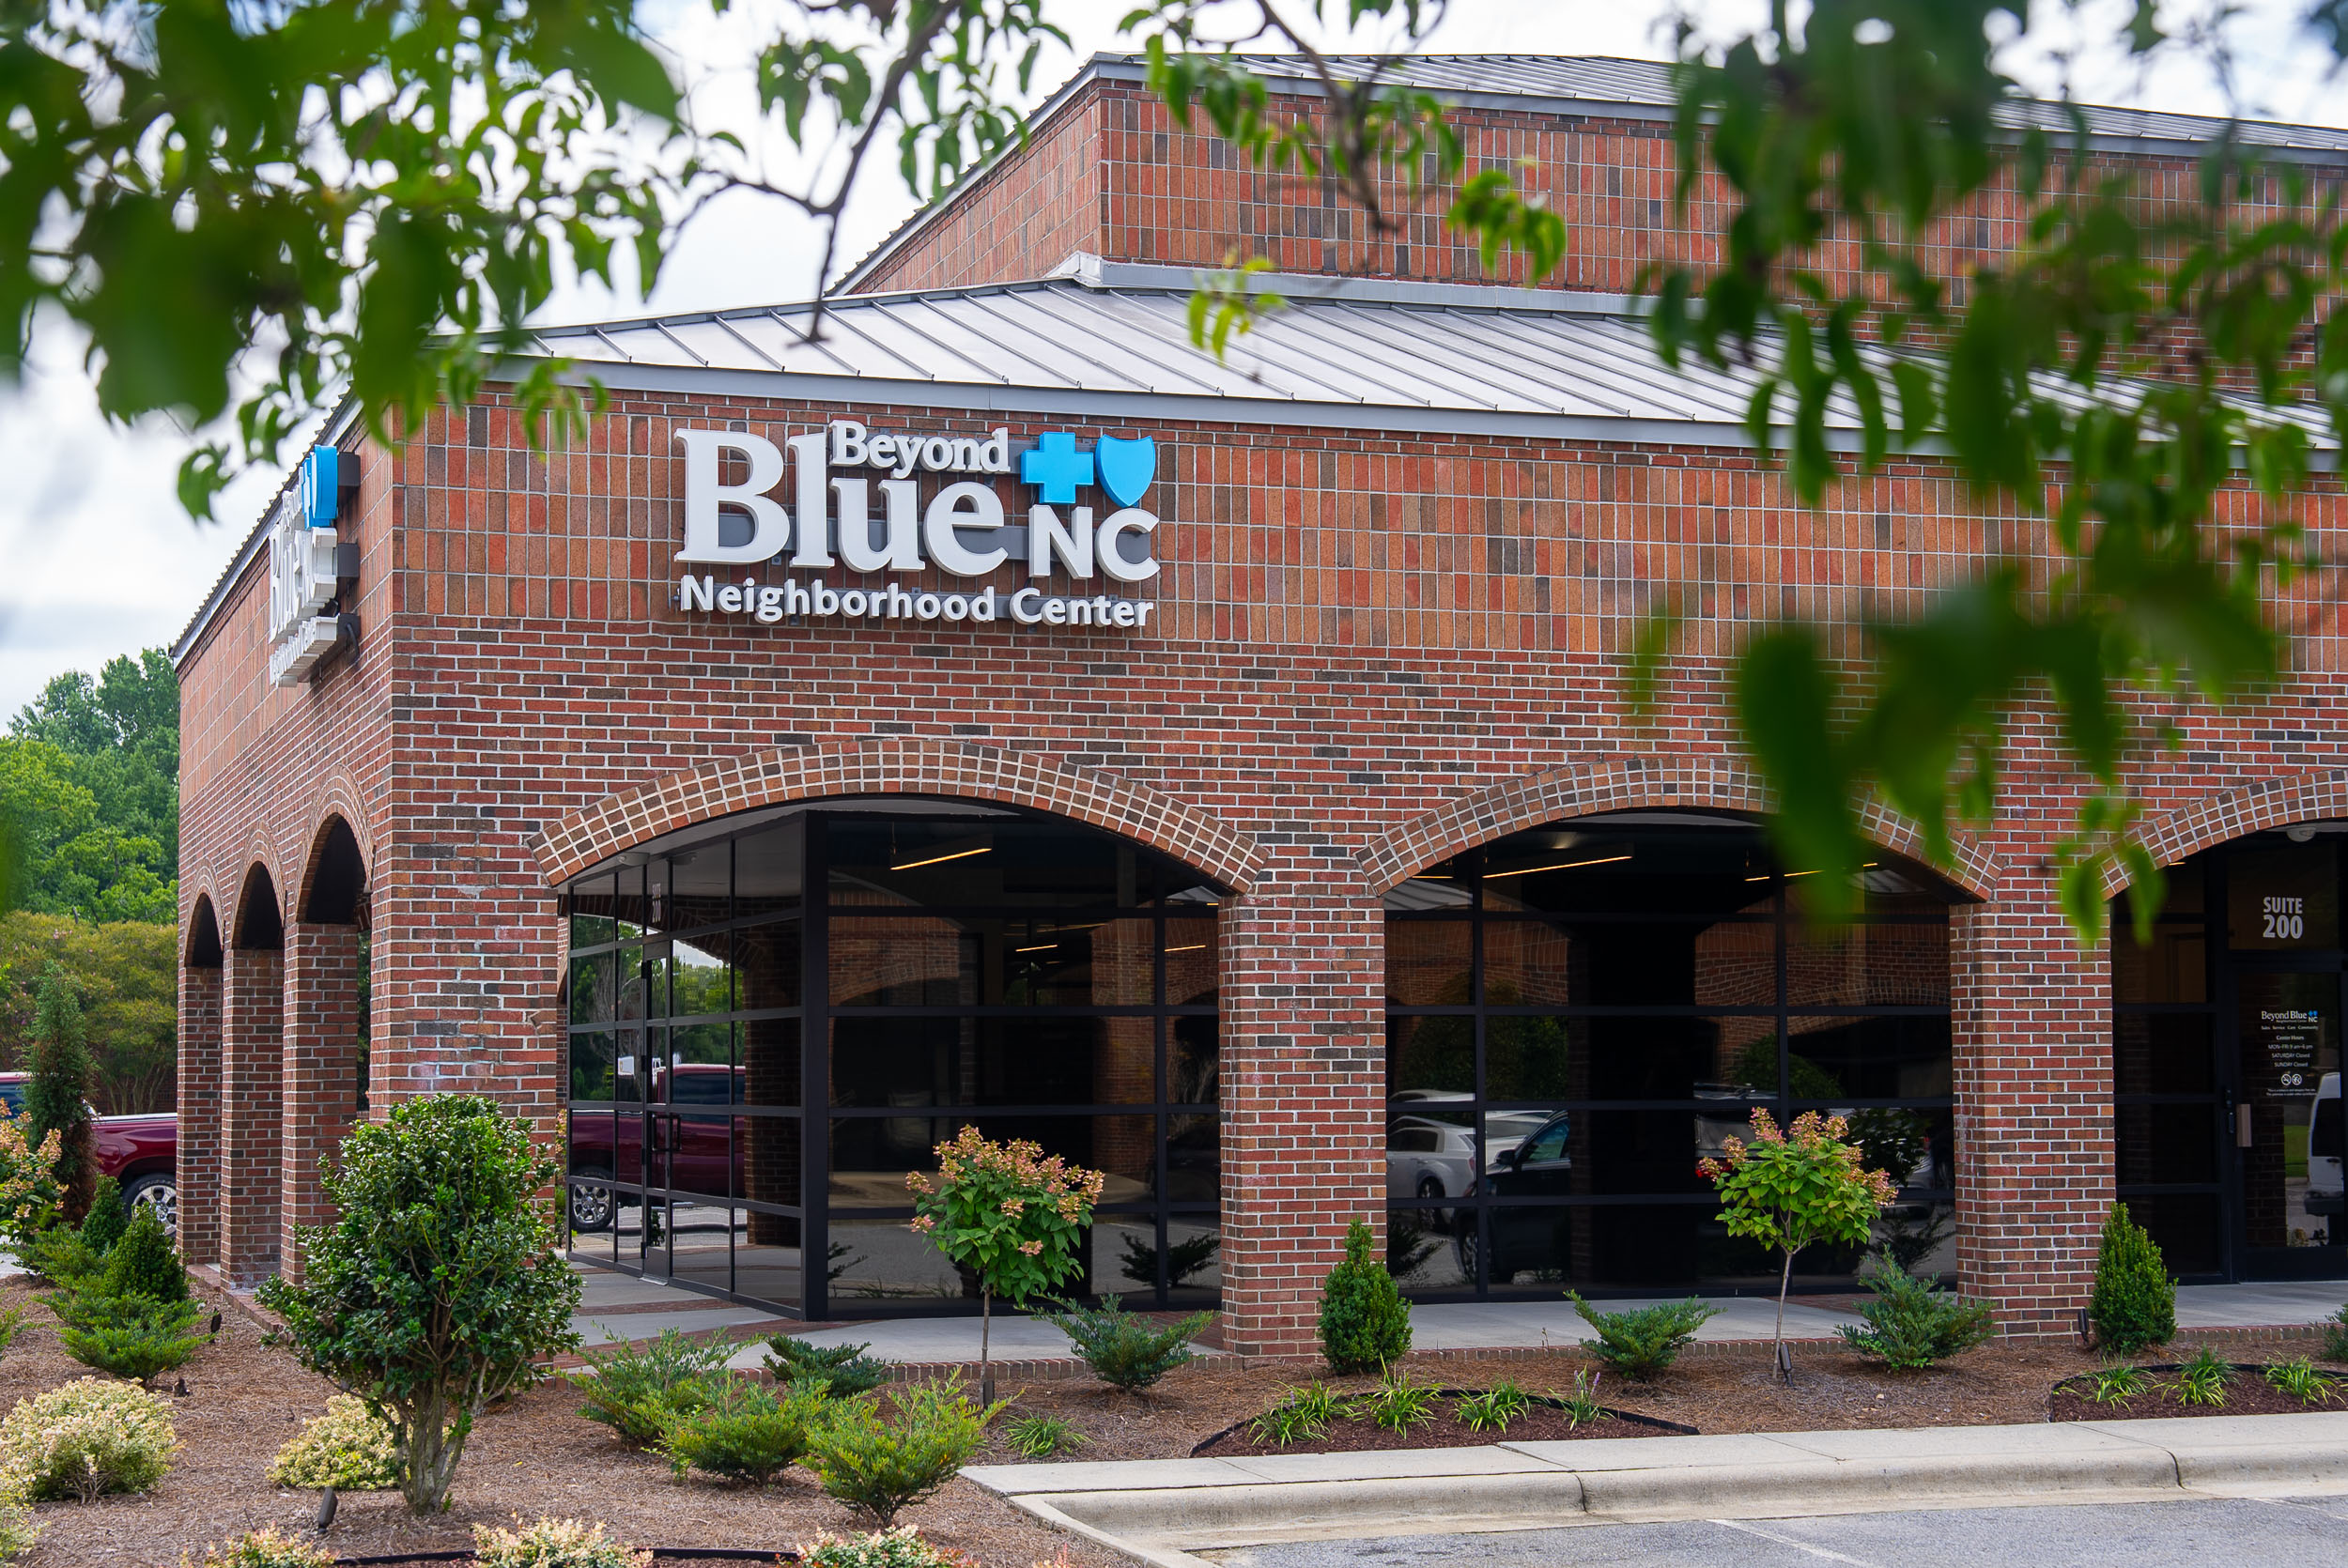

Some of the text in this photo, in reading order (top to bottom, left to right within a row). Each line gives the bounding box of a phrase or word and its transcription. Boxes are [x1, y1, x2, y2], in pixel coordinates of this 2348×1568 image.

[828, 419, 1011, 479] Beyond
[673, 427, 1161, 582] Blue NC
[680, 574, 1154, 628] Neighborhood Center
[2263, 897, 2303, 914] SUITE
[2263, 915, 2303, 939] 200
[2261, 1010, 2289, 1022] Beyond
[2290, 1009, 2307, 1020] Blue
